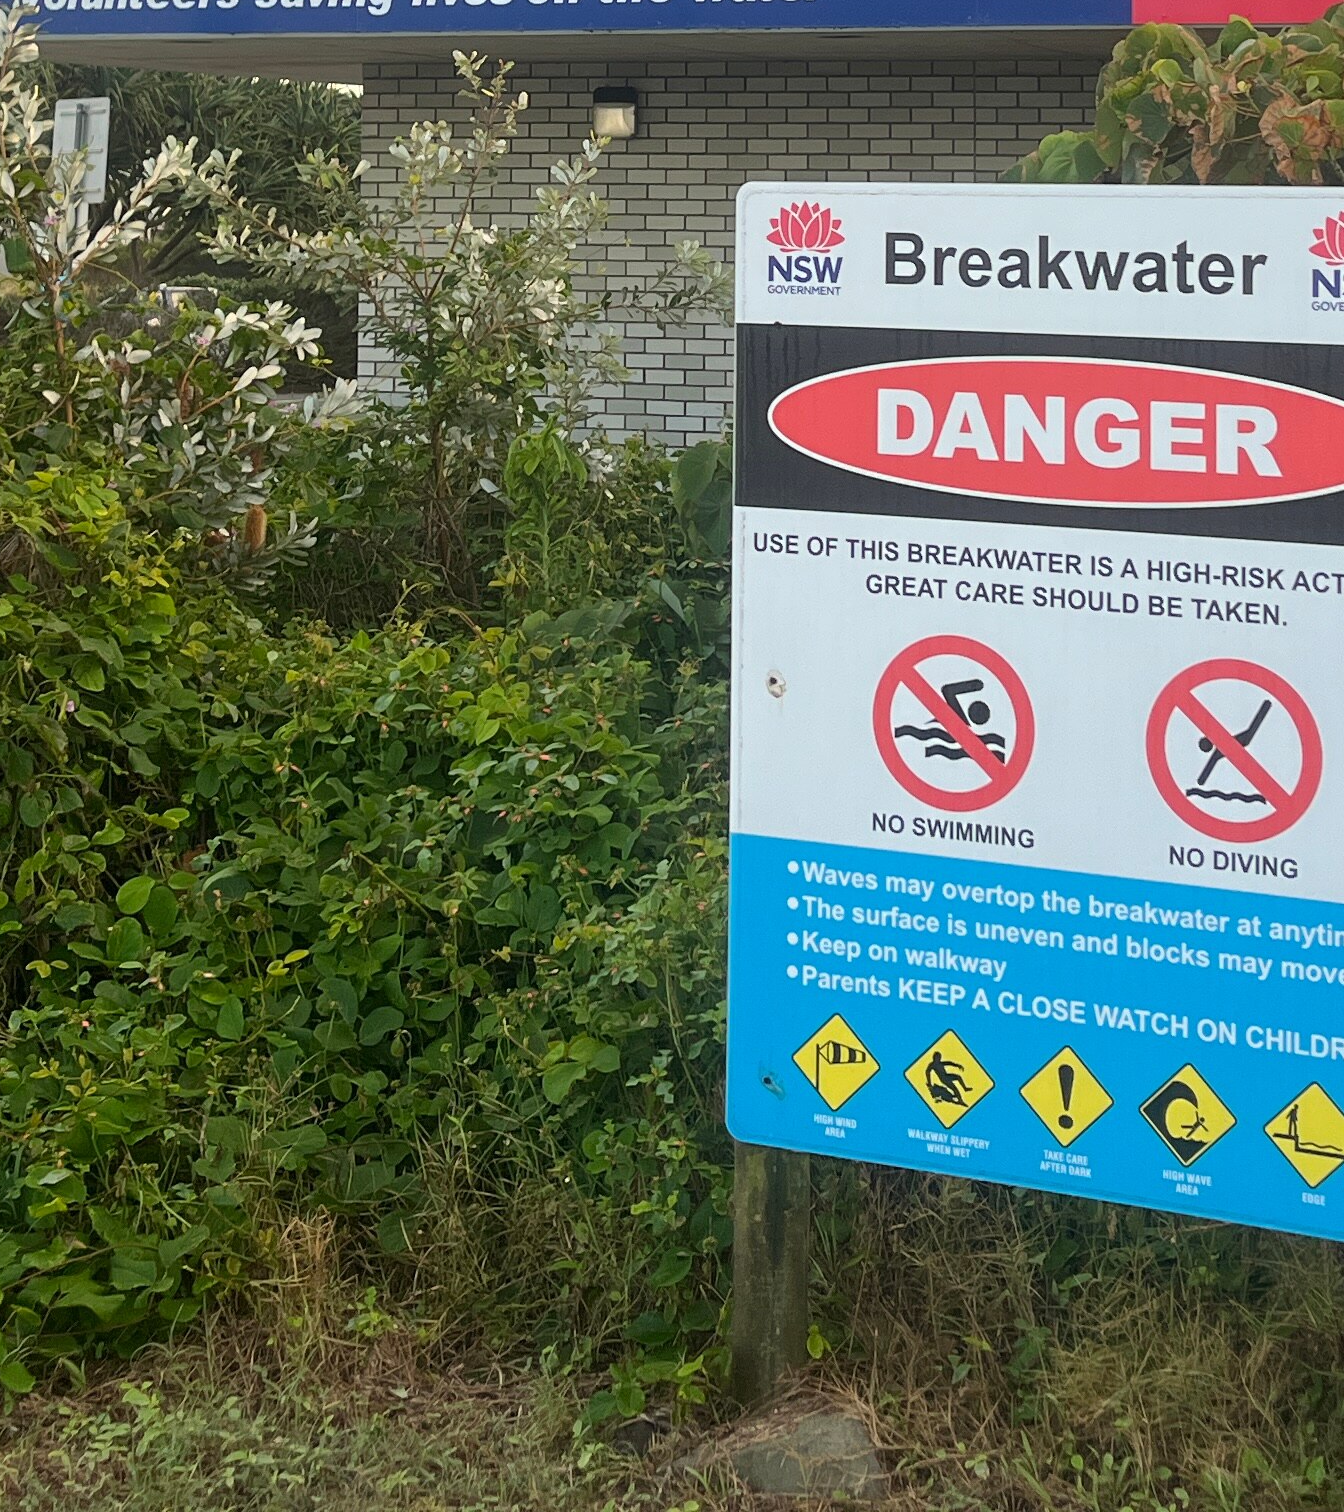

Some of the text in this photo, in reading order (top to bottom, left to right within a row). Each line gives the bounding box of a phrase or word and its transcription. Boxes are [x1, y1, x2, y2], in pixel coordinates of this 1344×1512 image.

[768, 255, 844, 283] NSW
[884, 231, 1268, 295] Breakwater
[767, 284, 842, 296] GOVERNMENT
[875, 388, 1284, 478] DANGER
[753, 532, 799, 555] USE
[806, 536, 839, 557] OF
[845, 538, 899, 562] THIS
[907, 543, 1083, 576] BREAKWATER
[1090, 555, 1113, 577] IS
[1119, 558, 1139, 580] A
[1147, 559, 1286, 591] HIGH-RISK
[865, 574, 1288, 627] GREAT CARE SHOULD BE TAKEN.
[871, 812, 1036, 849] NO SWIMMING
[1168, 844, 1300, 880] NO DIVING
[802, 859, 879, 891] Waves
[885, 873, 935, 902] may
[942, 881, 1035, 913] overtop
[1041, 890, 1081, 915] the
[1088, 894, 1231, 934] breakwater
[1236, 915, 1262, 938] at
[802, 895, 845, 921] The
[851, 906, 940, 933] surface
[947, 913, 968, 937] is
[975, 921, 1065, 949] uneven
[1071, 933, 1119, 956] and
[1126, 935, 1210, 968] blocks
[1218, 950, 1273, 981] may
[802, 930, 1007, 982] Keep on walkway
[802, 964, 891, 998] Parents
[898, 977, 966, 1007] KEEP
[971, 988, 991, 1011] A
[997, 991, 1087, 1024] CLOSE
[1092, 1003, 1190, 1039] WATCH
[1196, 1018, 1238, 1046] ON
[813, 1112, 858, 1129] HIGH WIND
[824, 1125, 846, 1139] AREA
[906, 1128, 991, 1151] WALKWAY SLIPPERY
[926, 1142, 971, 1159] WHEN WET
[1039, 1160, 1092, 1179] AFTER DARK
[1042, 1149, 1089, 1166] TAKE CARE
[1162, 1168, 1213, 1188] HIGH WAVE
[1175, 1182, 1200, 1197] AREA
[1301, 1192, 1326, 1207] EDGE
